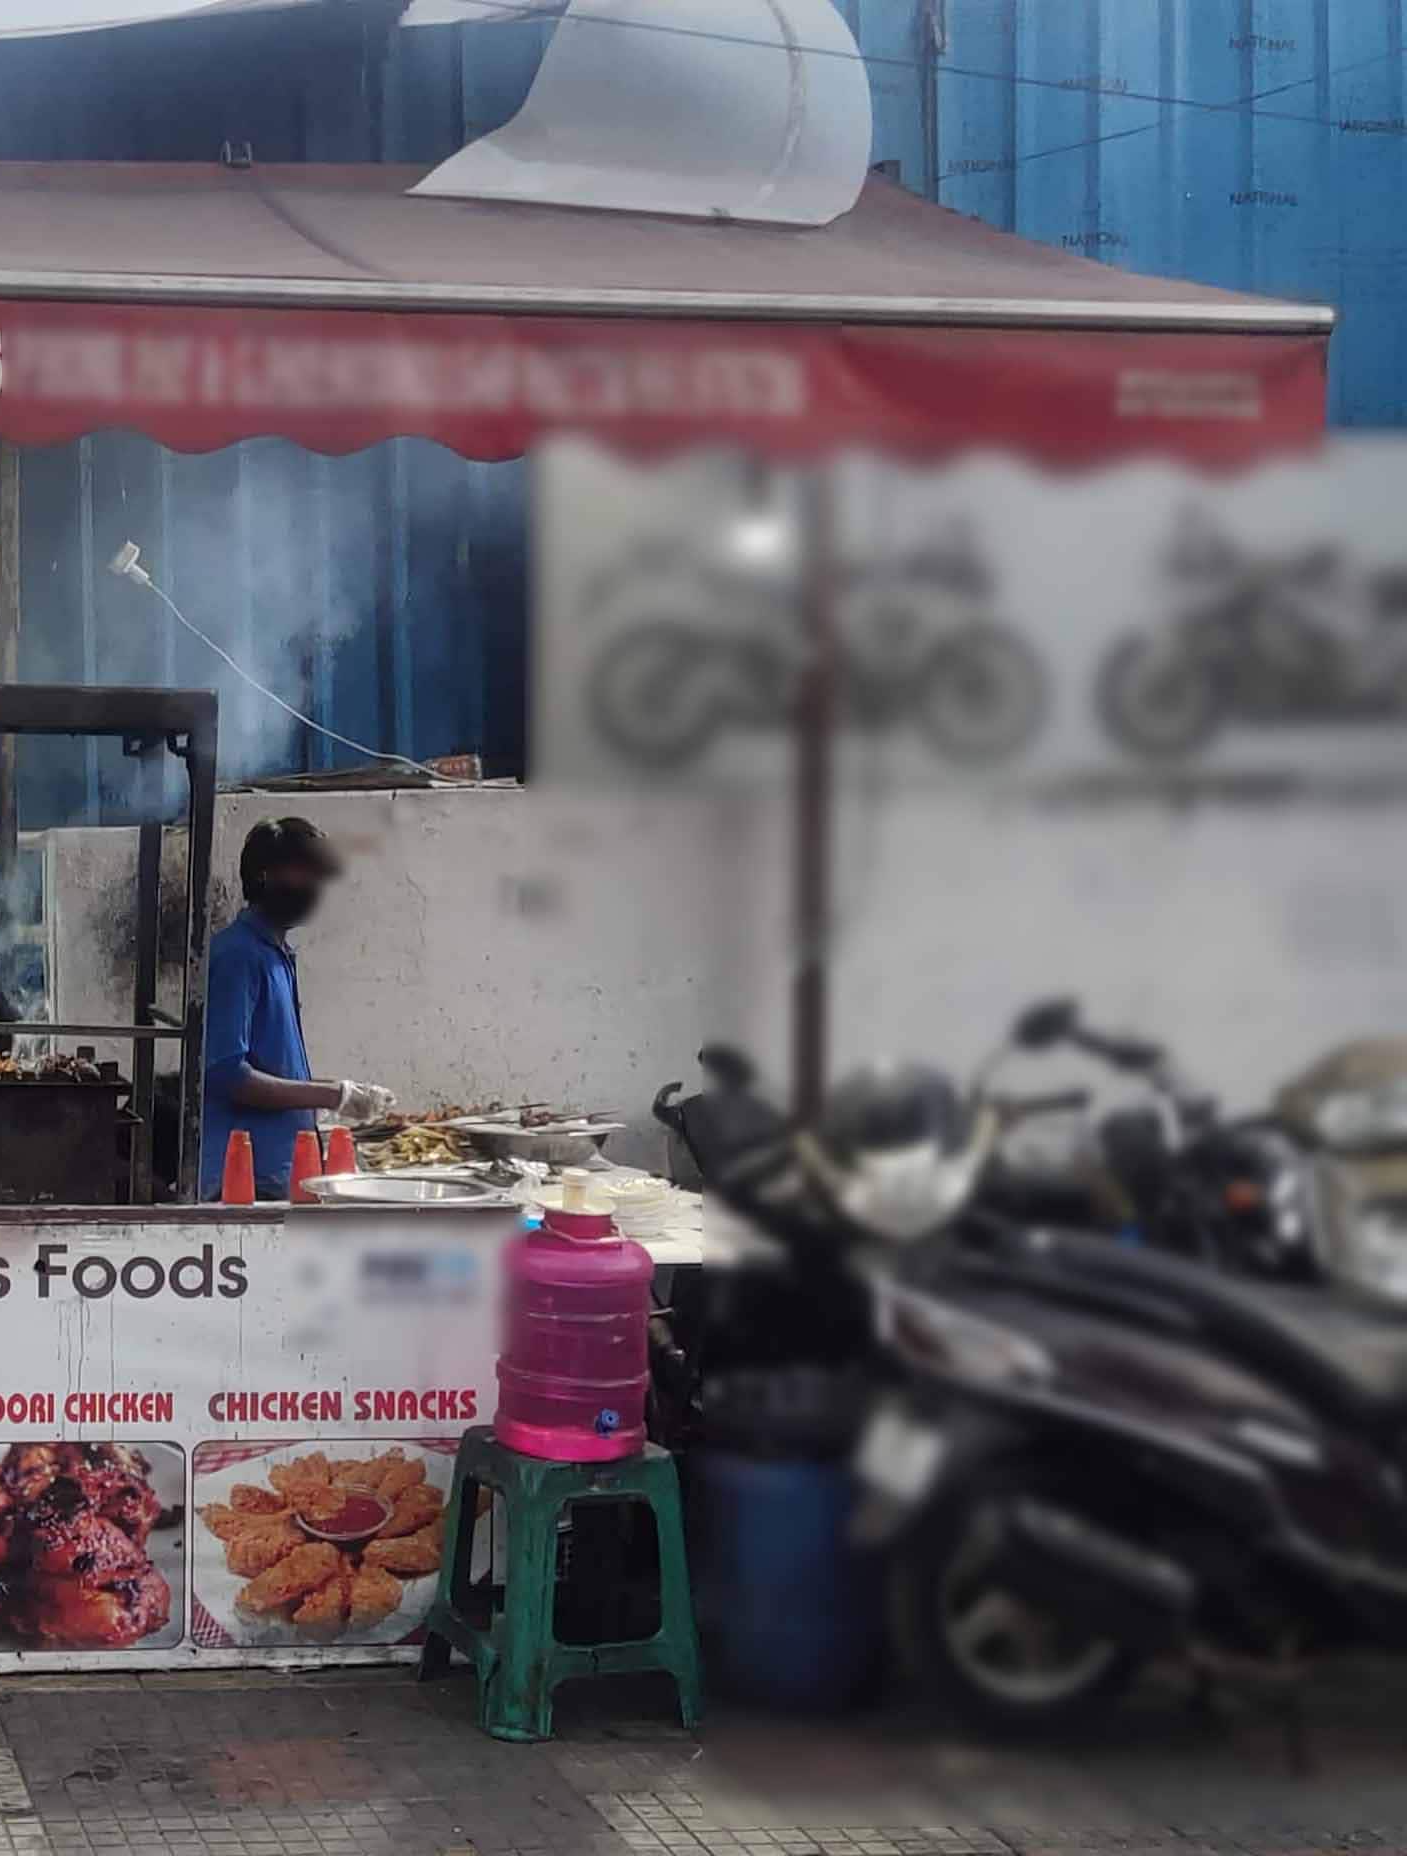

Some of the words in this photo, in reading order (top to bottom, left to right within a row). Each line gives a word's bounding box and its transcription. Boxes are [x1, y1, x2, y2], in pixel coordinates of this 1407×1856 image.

[37, 1244, 249, 1301] Foods
[64, 1392, 174, 1424] CHICKEN
[208, 1391, 342, 1422] CHICKEN
[354, 1390, 478, 1421] SNACKS
